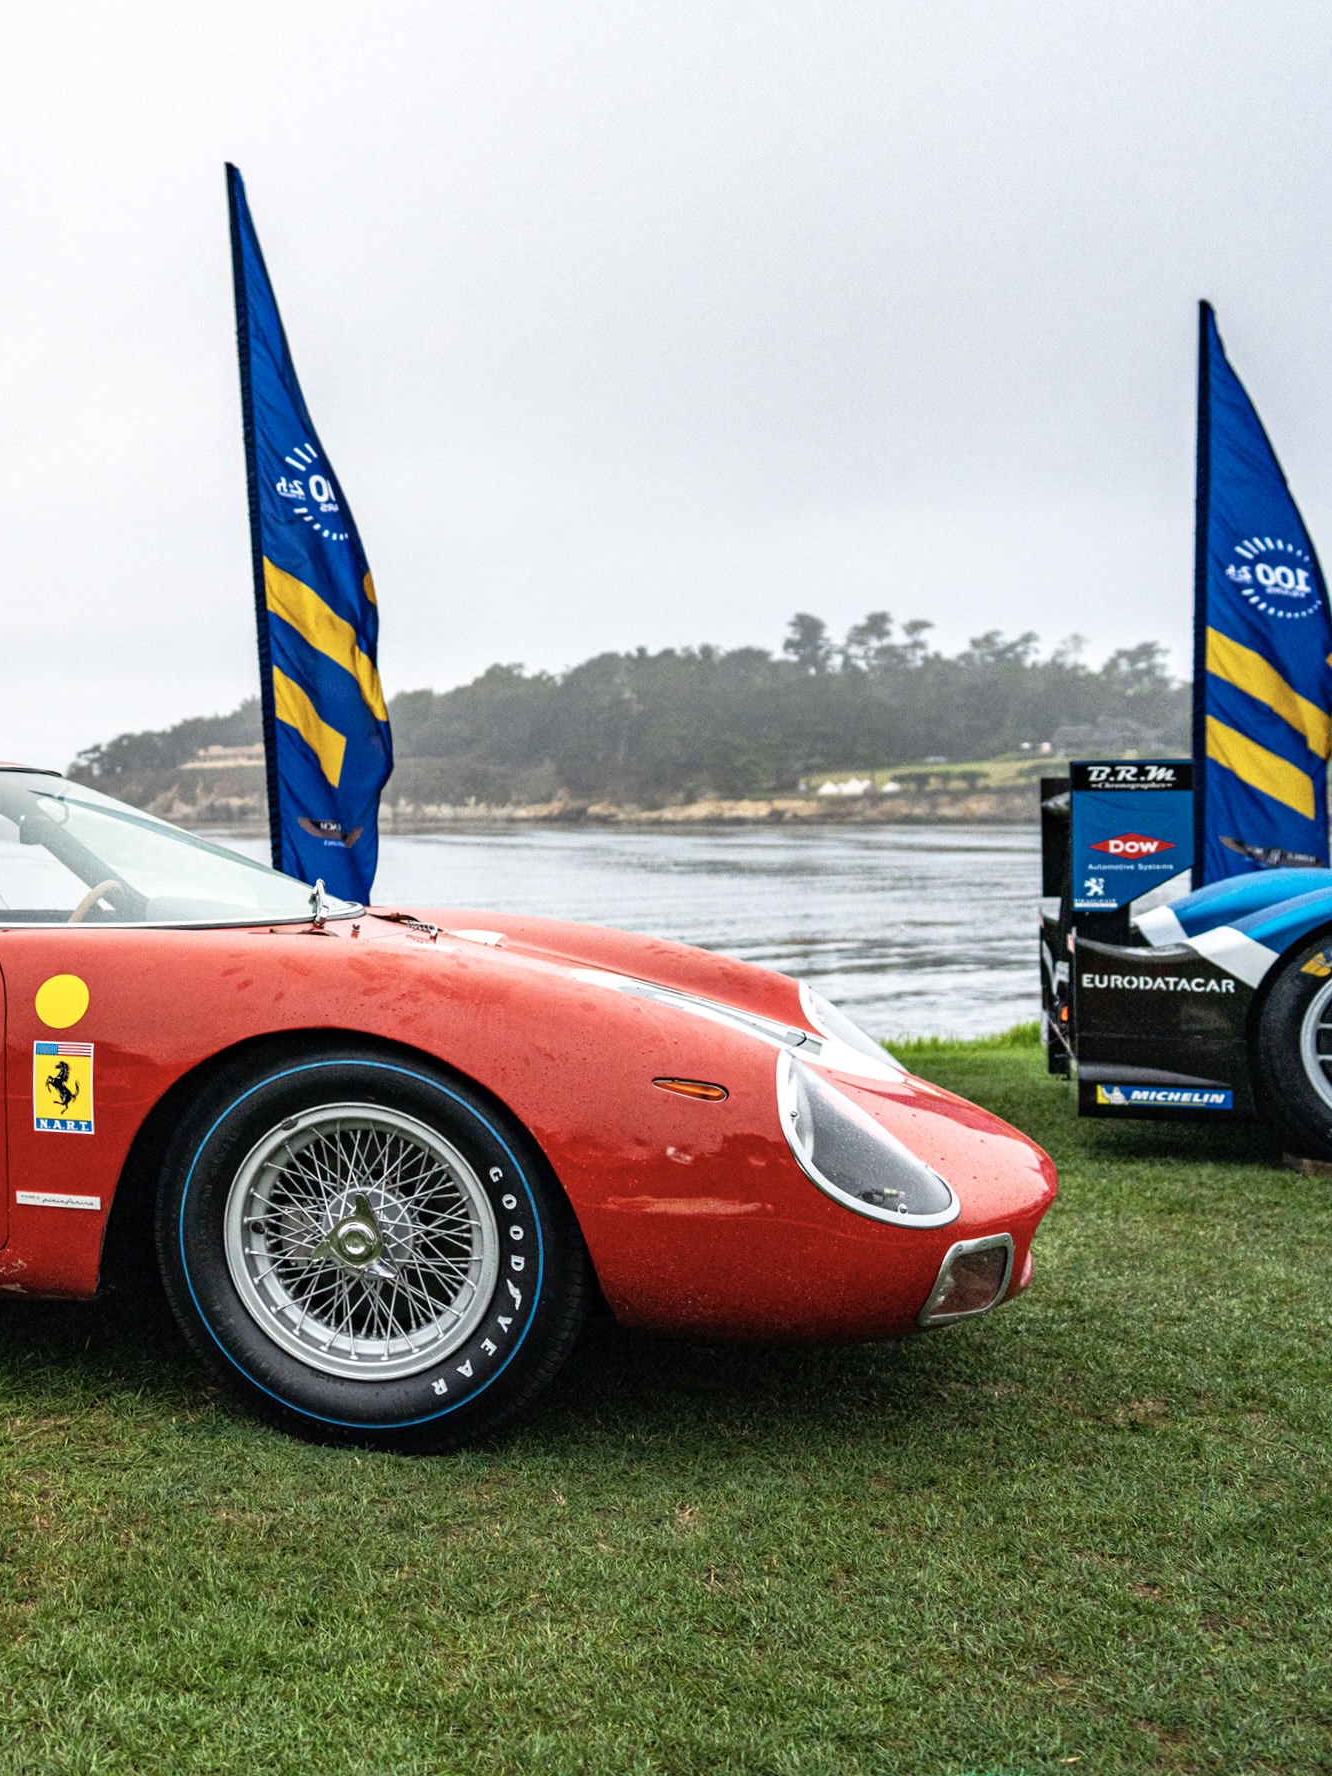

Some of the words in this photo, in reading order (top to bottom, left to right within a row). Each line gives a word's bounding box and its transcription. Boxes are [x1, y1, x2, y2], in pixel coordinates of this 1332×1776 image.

[1087, 766, 1176, 781] B.R.M
[1088, 863, 1135, 871] Automotive
[1138, 863, 1174, 871] Systems
[1082, 973, 1235, 993] EURODATACAR
[1131, 1090, 1226, 1104] MICHELIN
[39, 1118, 90, 1131] N.A.R.T.
[431, 1165, 526, 1396] GOODYEAR
